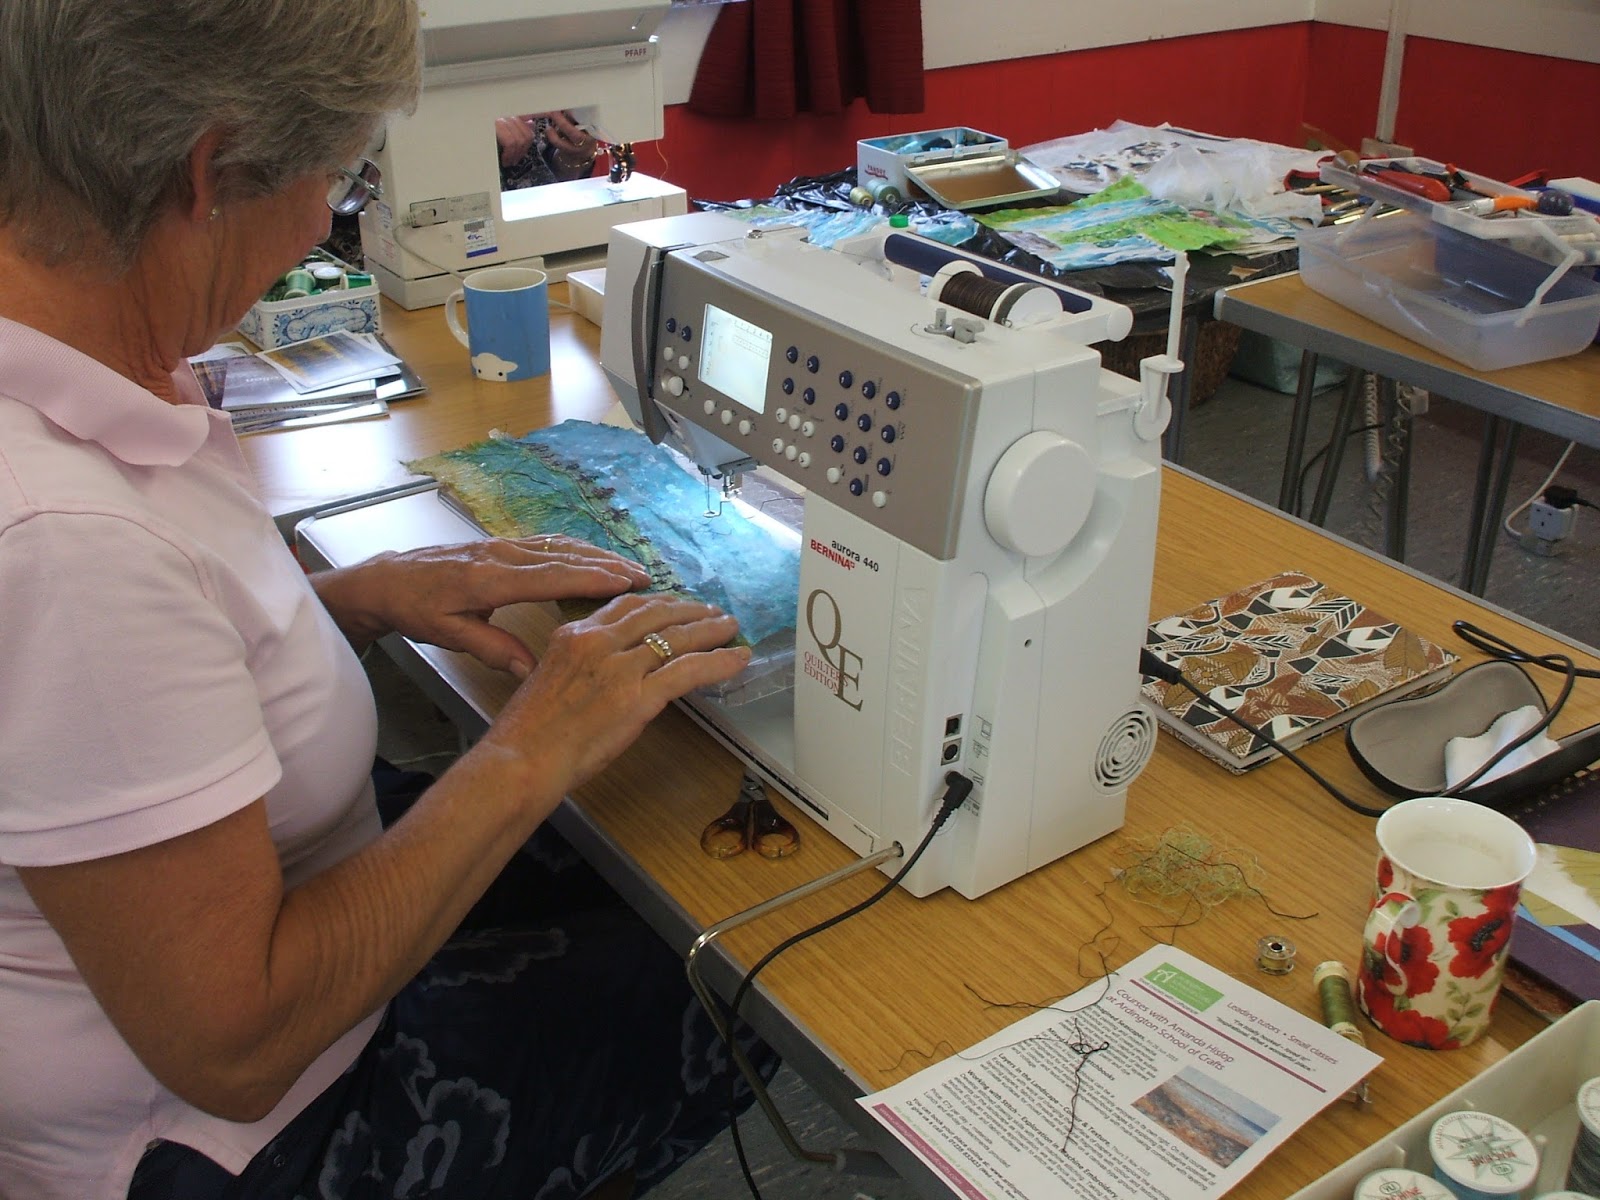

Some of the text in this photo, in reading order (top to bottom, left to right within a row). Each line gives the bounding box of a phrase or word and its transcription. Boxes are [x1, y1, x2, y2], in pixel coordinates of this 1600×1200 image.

[625, 48, 647, 57] PFAFF
[810, 539, 851, 570] BERNINA
[831, 540, 879, 572] aurora 440
[806, 588, 863, 712] QE
[1105, 995, 1117, 1003] at
[1114, 1002, 1158, 1031] Ardington
[1157, 1028, 1190, 1049] School
[1187, 1047, 1201, 1055] of
[1198, 1053, 1225, 1070] Crafts
[1116, 989, 1149, 1012] Courses
[1148, 1010, 1169, 1024] with
[1167, 1023, 1206, 1047] Amanda
[1205, 1044, 1234, 1062] Hislop
[1117, 1019, 1145, 1041] Seascapes,
[1226, 1002, 1338, 1064] Leading tutors Small classes
[1242, 1025, 1259, 1036] totally
[1260, 1034, 1281, 1047] hooked
[1283, 1047, 1301, 1057] loved
[1249, 1036, 1265, 1045] What
[1268, 1046, 1296, 1062] wonderful
[998, 1052, 1016, 1068] Layers
[1020, 1072, 1032, 1081] the
[1030, 1080, 1059, 1104] Landscape
[967, 1069, 989, 1090] Working
[988, 1089, 1002, 1100] with
[1000, 1099, 1017, 1113] Stitch
[1020, 1116, 1053, 1143] Exploration
